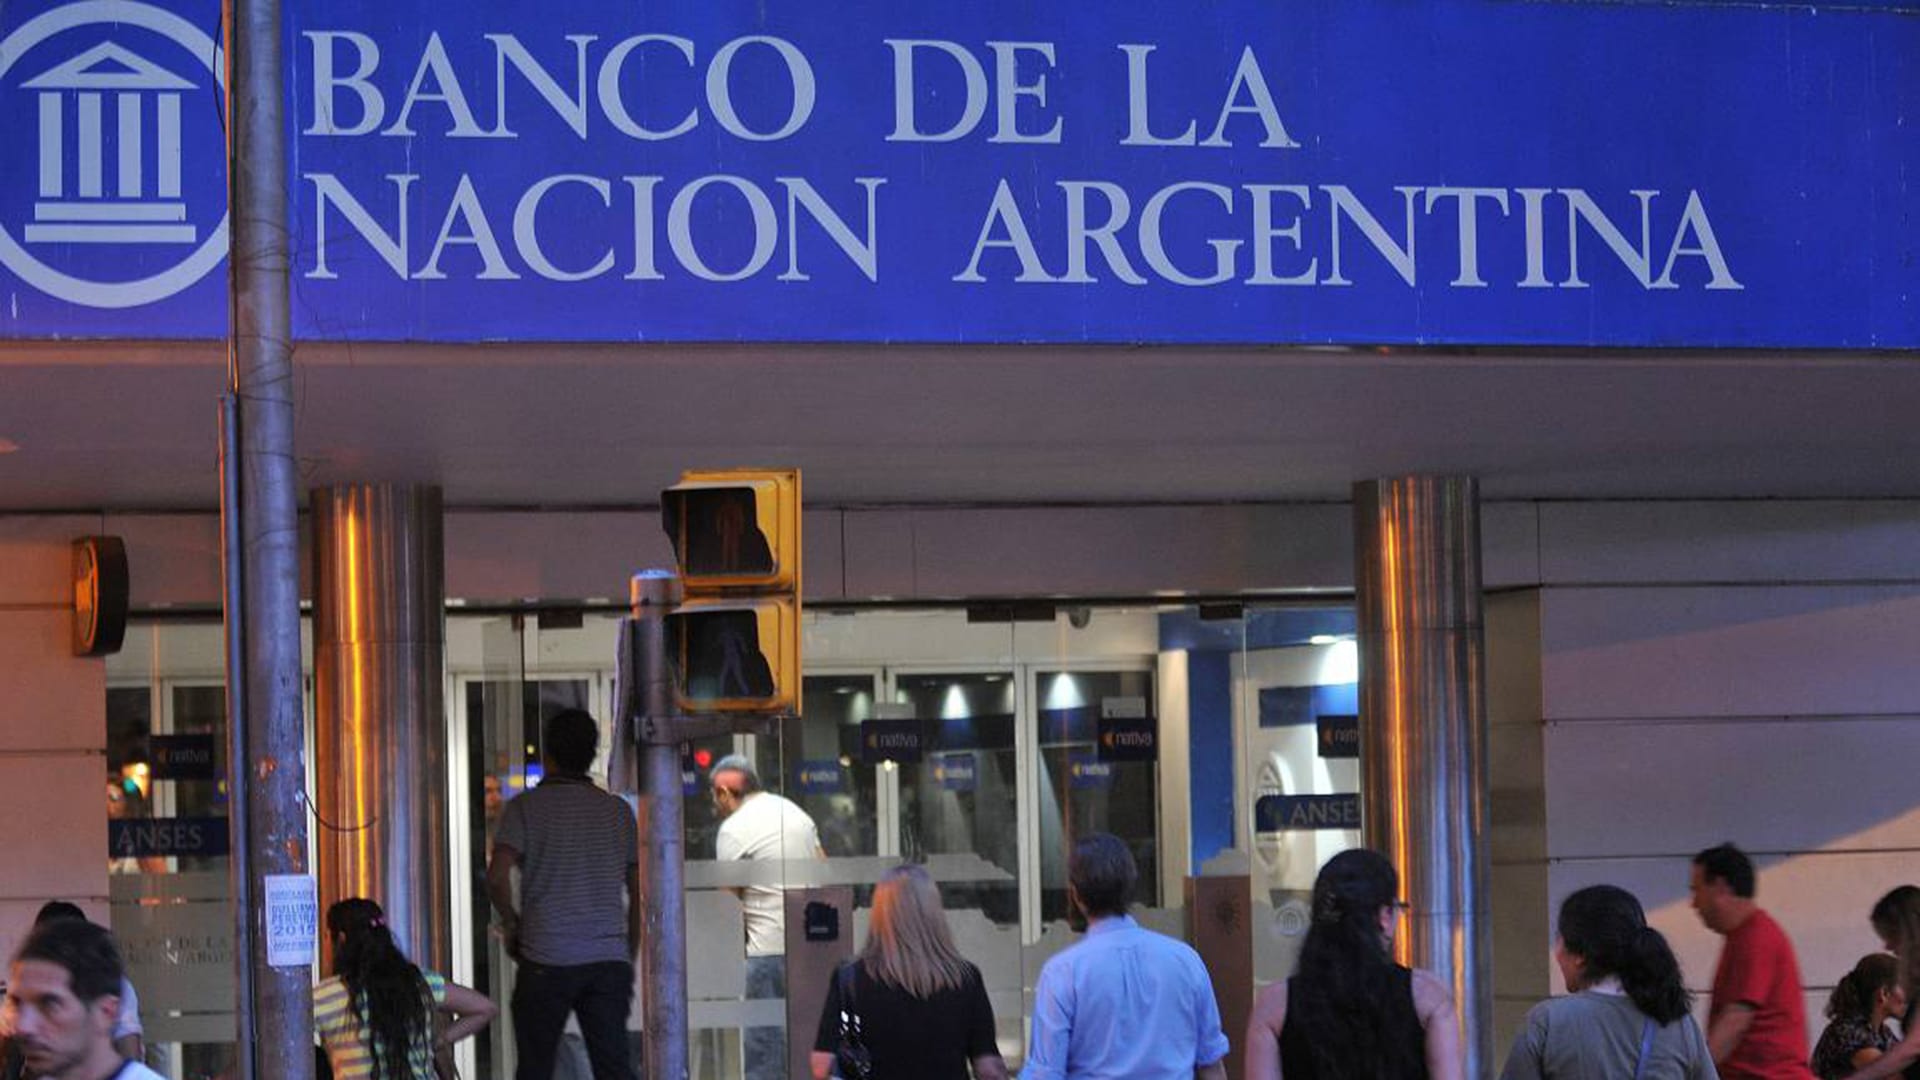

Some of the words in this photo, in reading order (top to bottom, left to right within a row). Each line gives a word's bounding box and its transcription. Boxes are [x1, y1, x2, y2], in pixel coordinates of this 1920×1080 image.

[303, 31, 816, 141] BANCO
[884, 39, 1063, 144] DE
[1118, 44, 1301, 150] LA
[303, 173, 887, 282] NACION
[953, 178, 1744, 290] ARGENTINA
[880, 732, 918, 748] nativa
[1117, 731, 1152, 746] nativa
[1289, 800, 1361, 825] ANSE
[118, 825, 203, 851] ANSES
